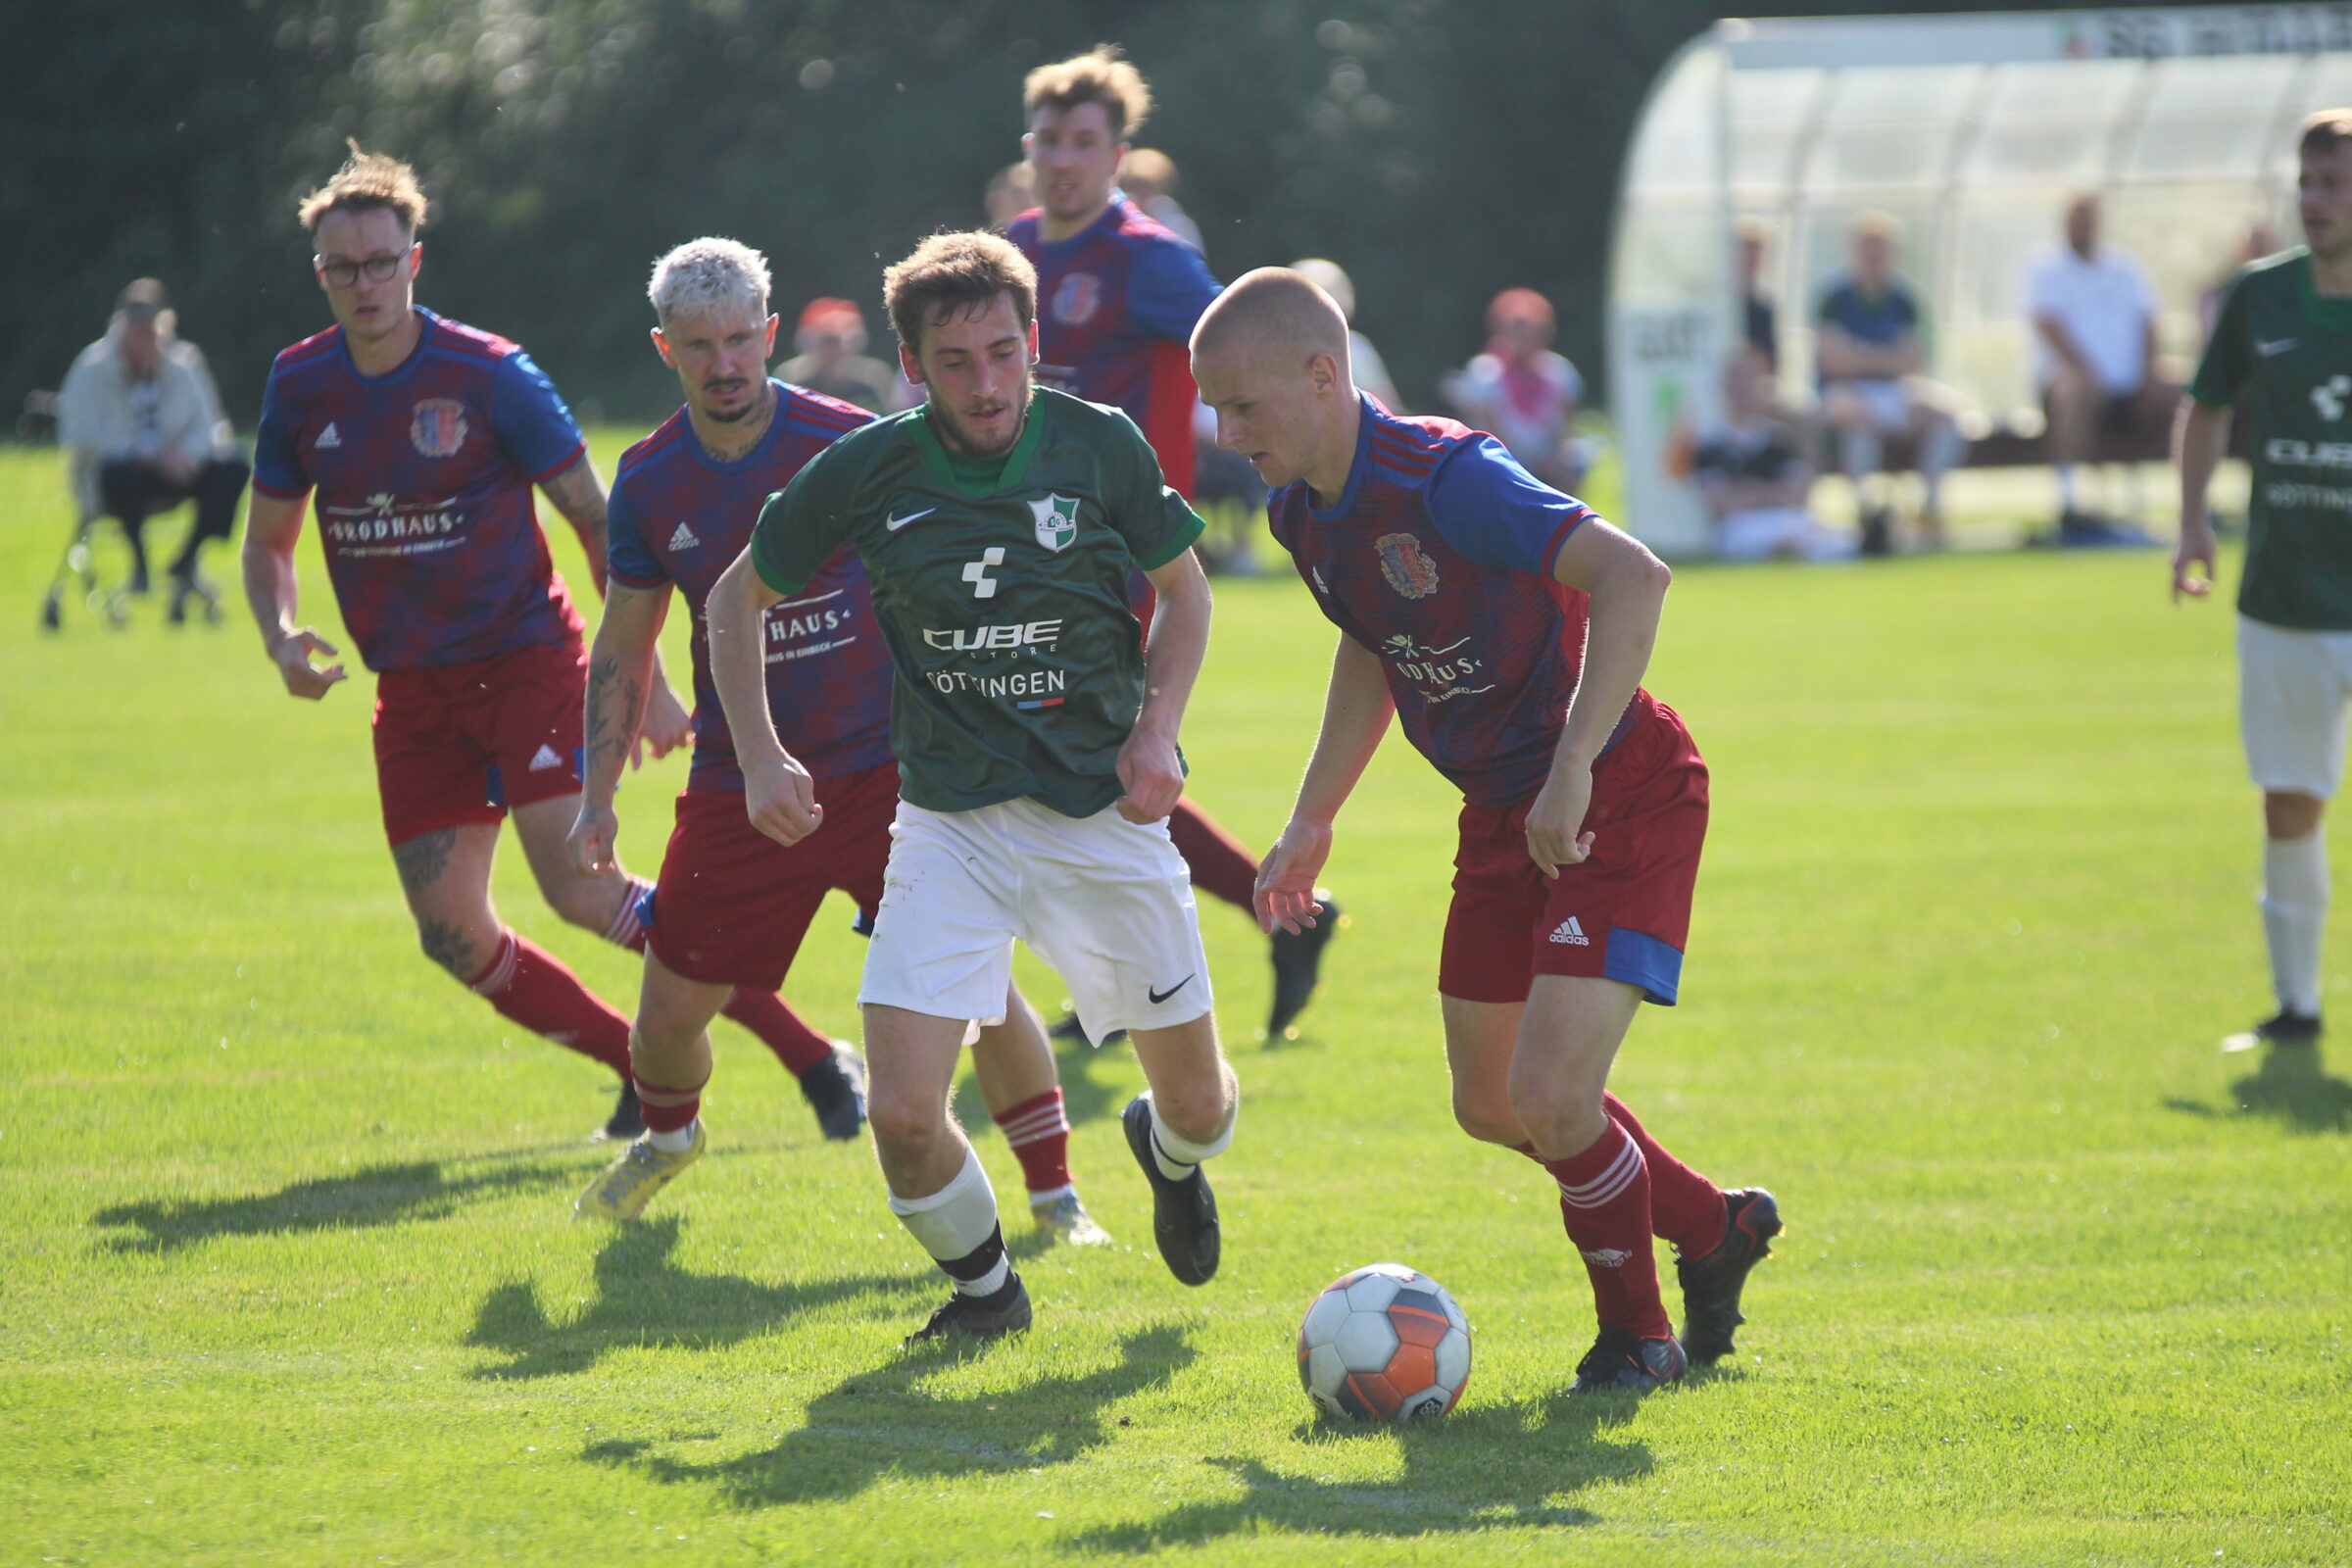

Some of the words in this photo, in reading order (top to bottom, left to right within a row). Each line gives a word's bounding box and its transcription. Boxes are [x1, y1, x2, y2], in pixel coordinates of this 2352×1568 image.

[769, 610, 840, 642] HAUS
[922, 618, 1063, 651] CUBE
[969, 643, 1057, 660] STORE
[1549, 933, 1590, 947] adidas
